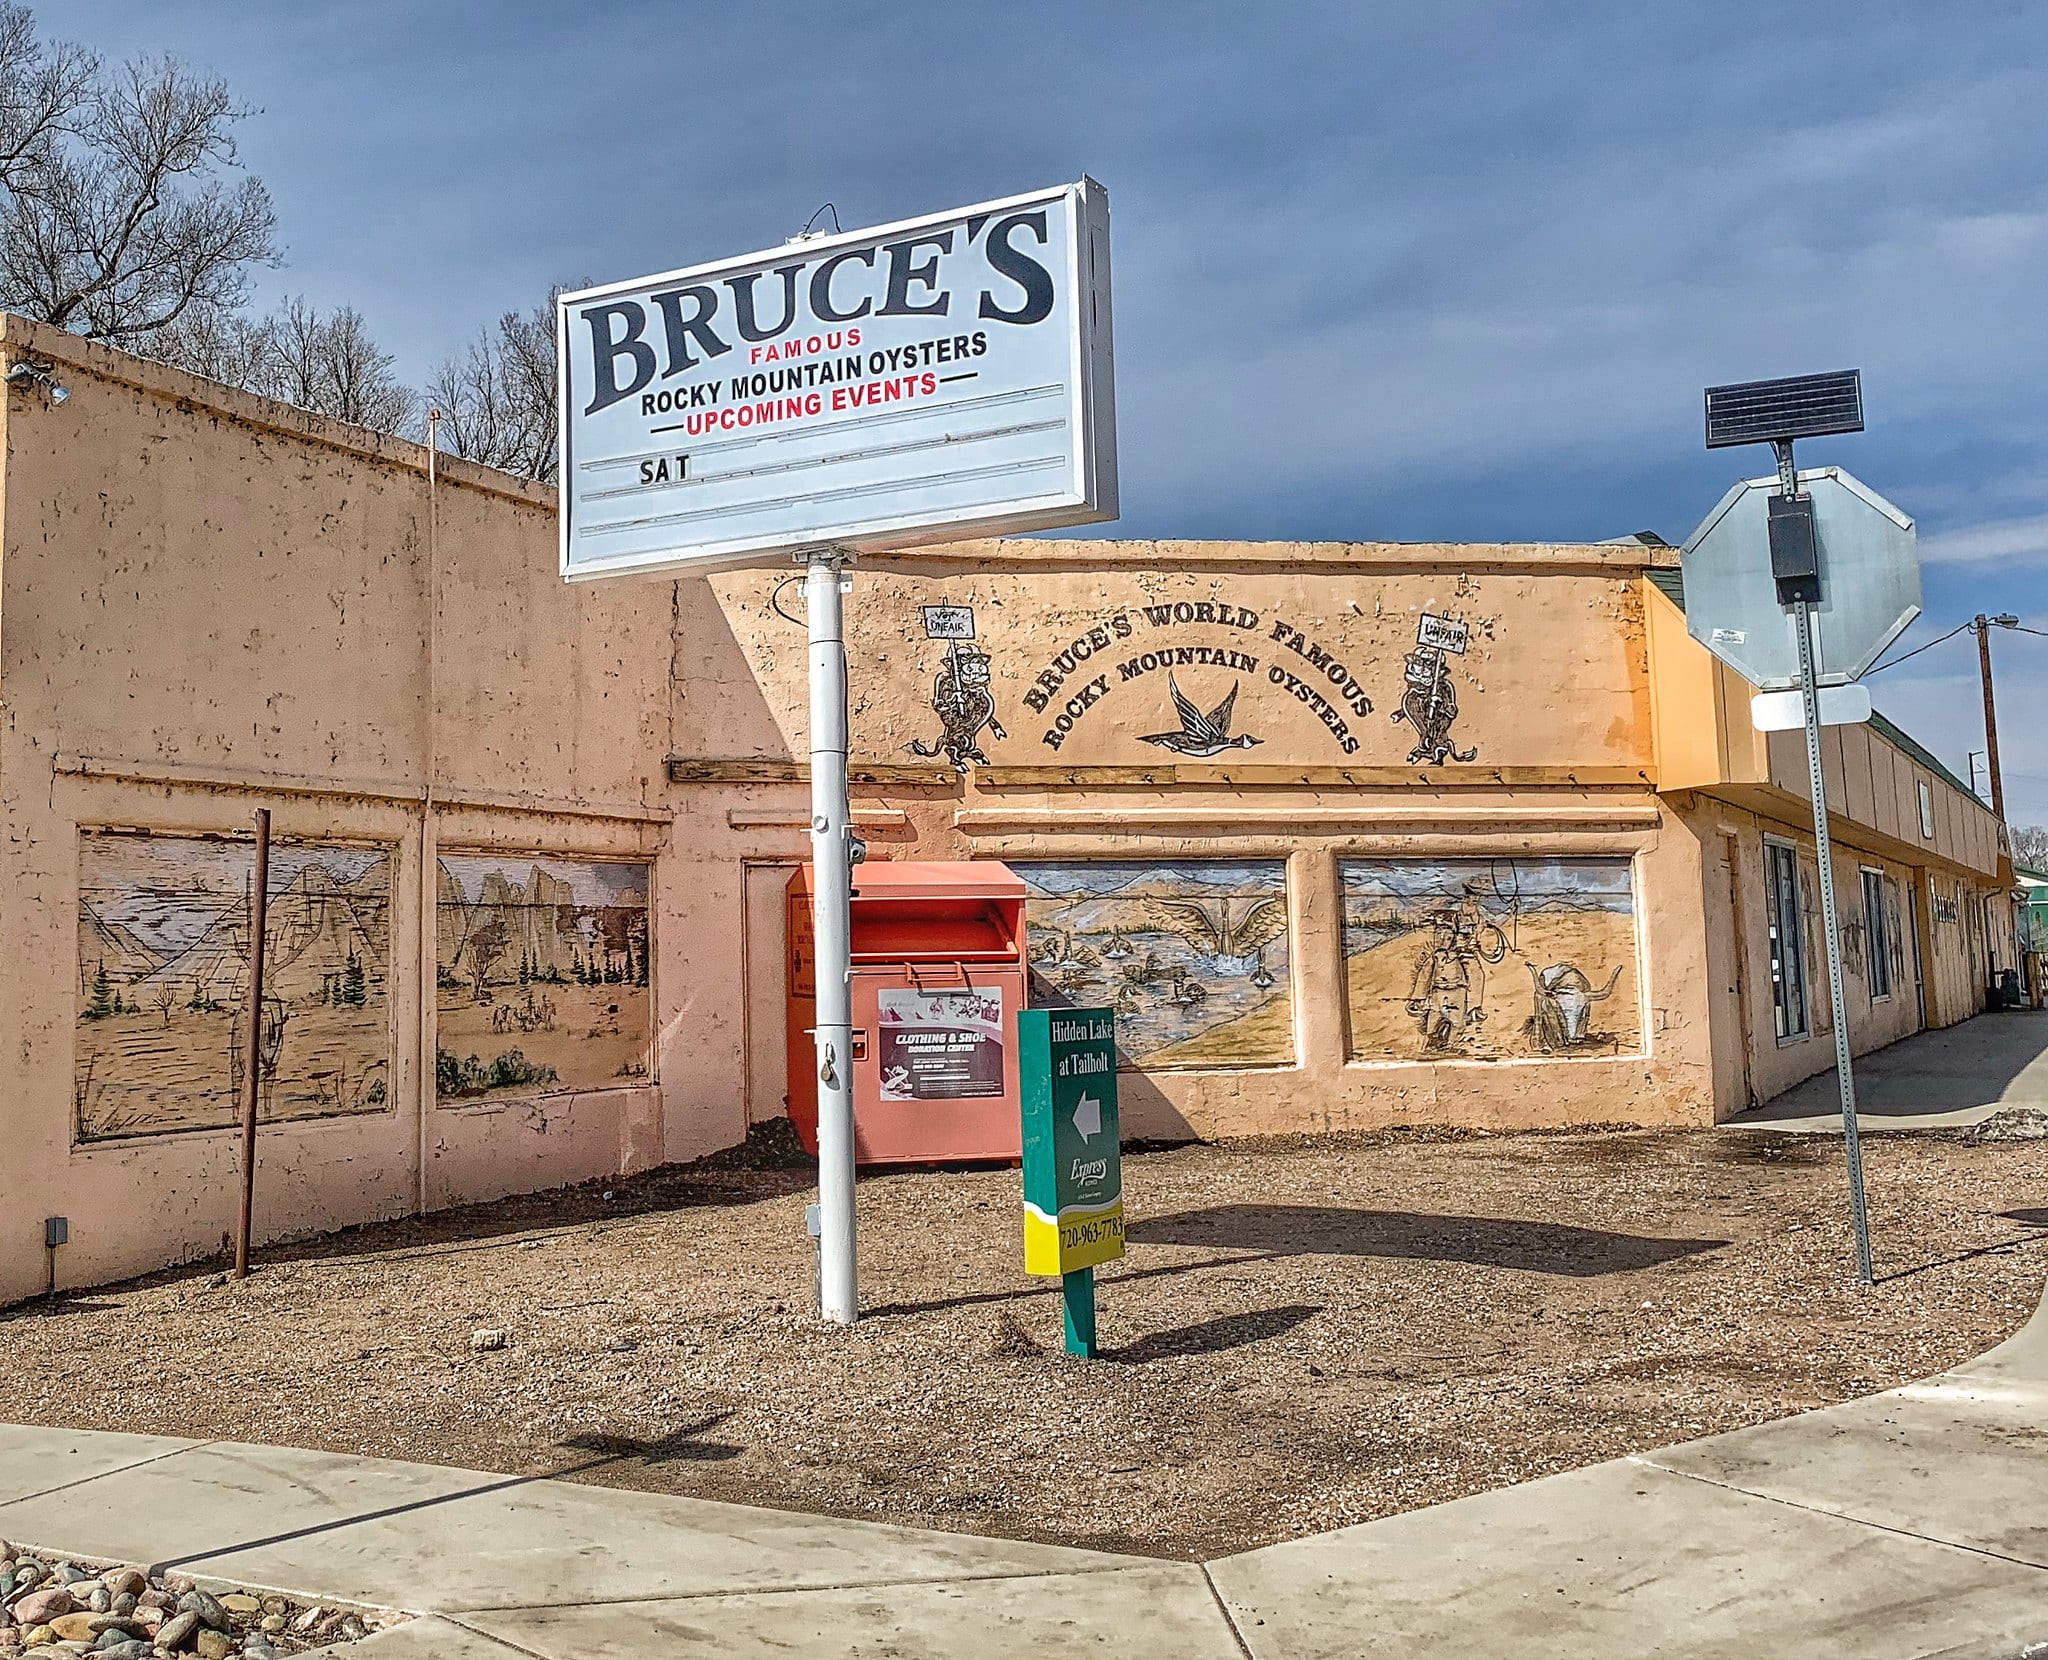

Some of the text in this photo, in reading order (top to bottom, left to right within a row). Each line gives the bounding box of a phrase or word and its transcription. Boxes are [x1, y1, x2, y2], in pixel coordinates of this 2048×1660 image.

[580, 210, 1055, 417] BRUCE'S
[750, 328, 861, 365] FAMOUS
[641, 331, 988, 416] ROCKY MOUNTAIN OYSTERS
[686, 372, 937, 436] UPCOMING EVENTS
[1023, 602, 1375, 718] BRUCE'S WORLD FAMOUS
[1042, 647, 1361, 755] ROCKY MOUNTAIN OYSTERS
[896, 1033, 987, 1045] CLOTHING & SHOE
[1052, 1019, 1113, 1042] Hidden Lake
[908, 1044, 975, 1053] DONATION CENTER
[1059, 1052, 1108, 1076] at Tailholt
[1070, 1158, 1107, 1188] Express
[1061, 1216, 1124, 1250] 720-963-7783
